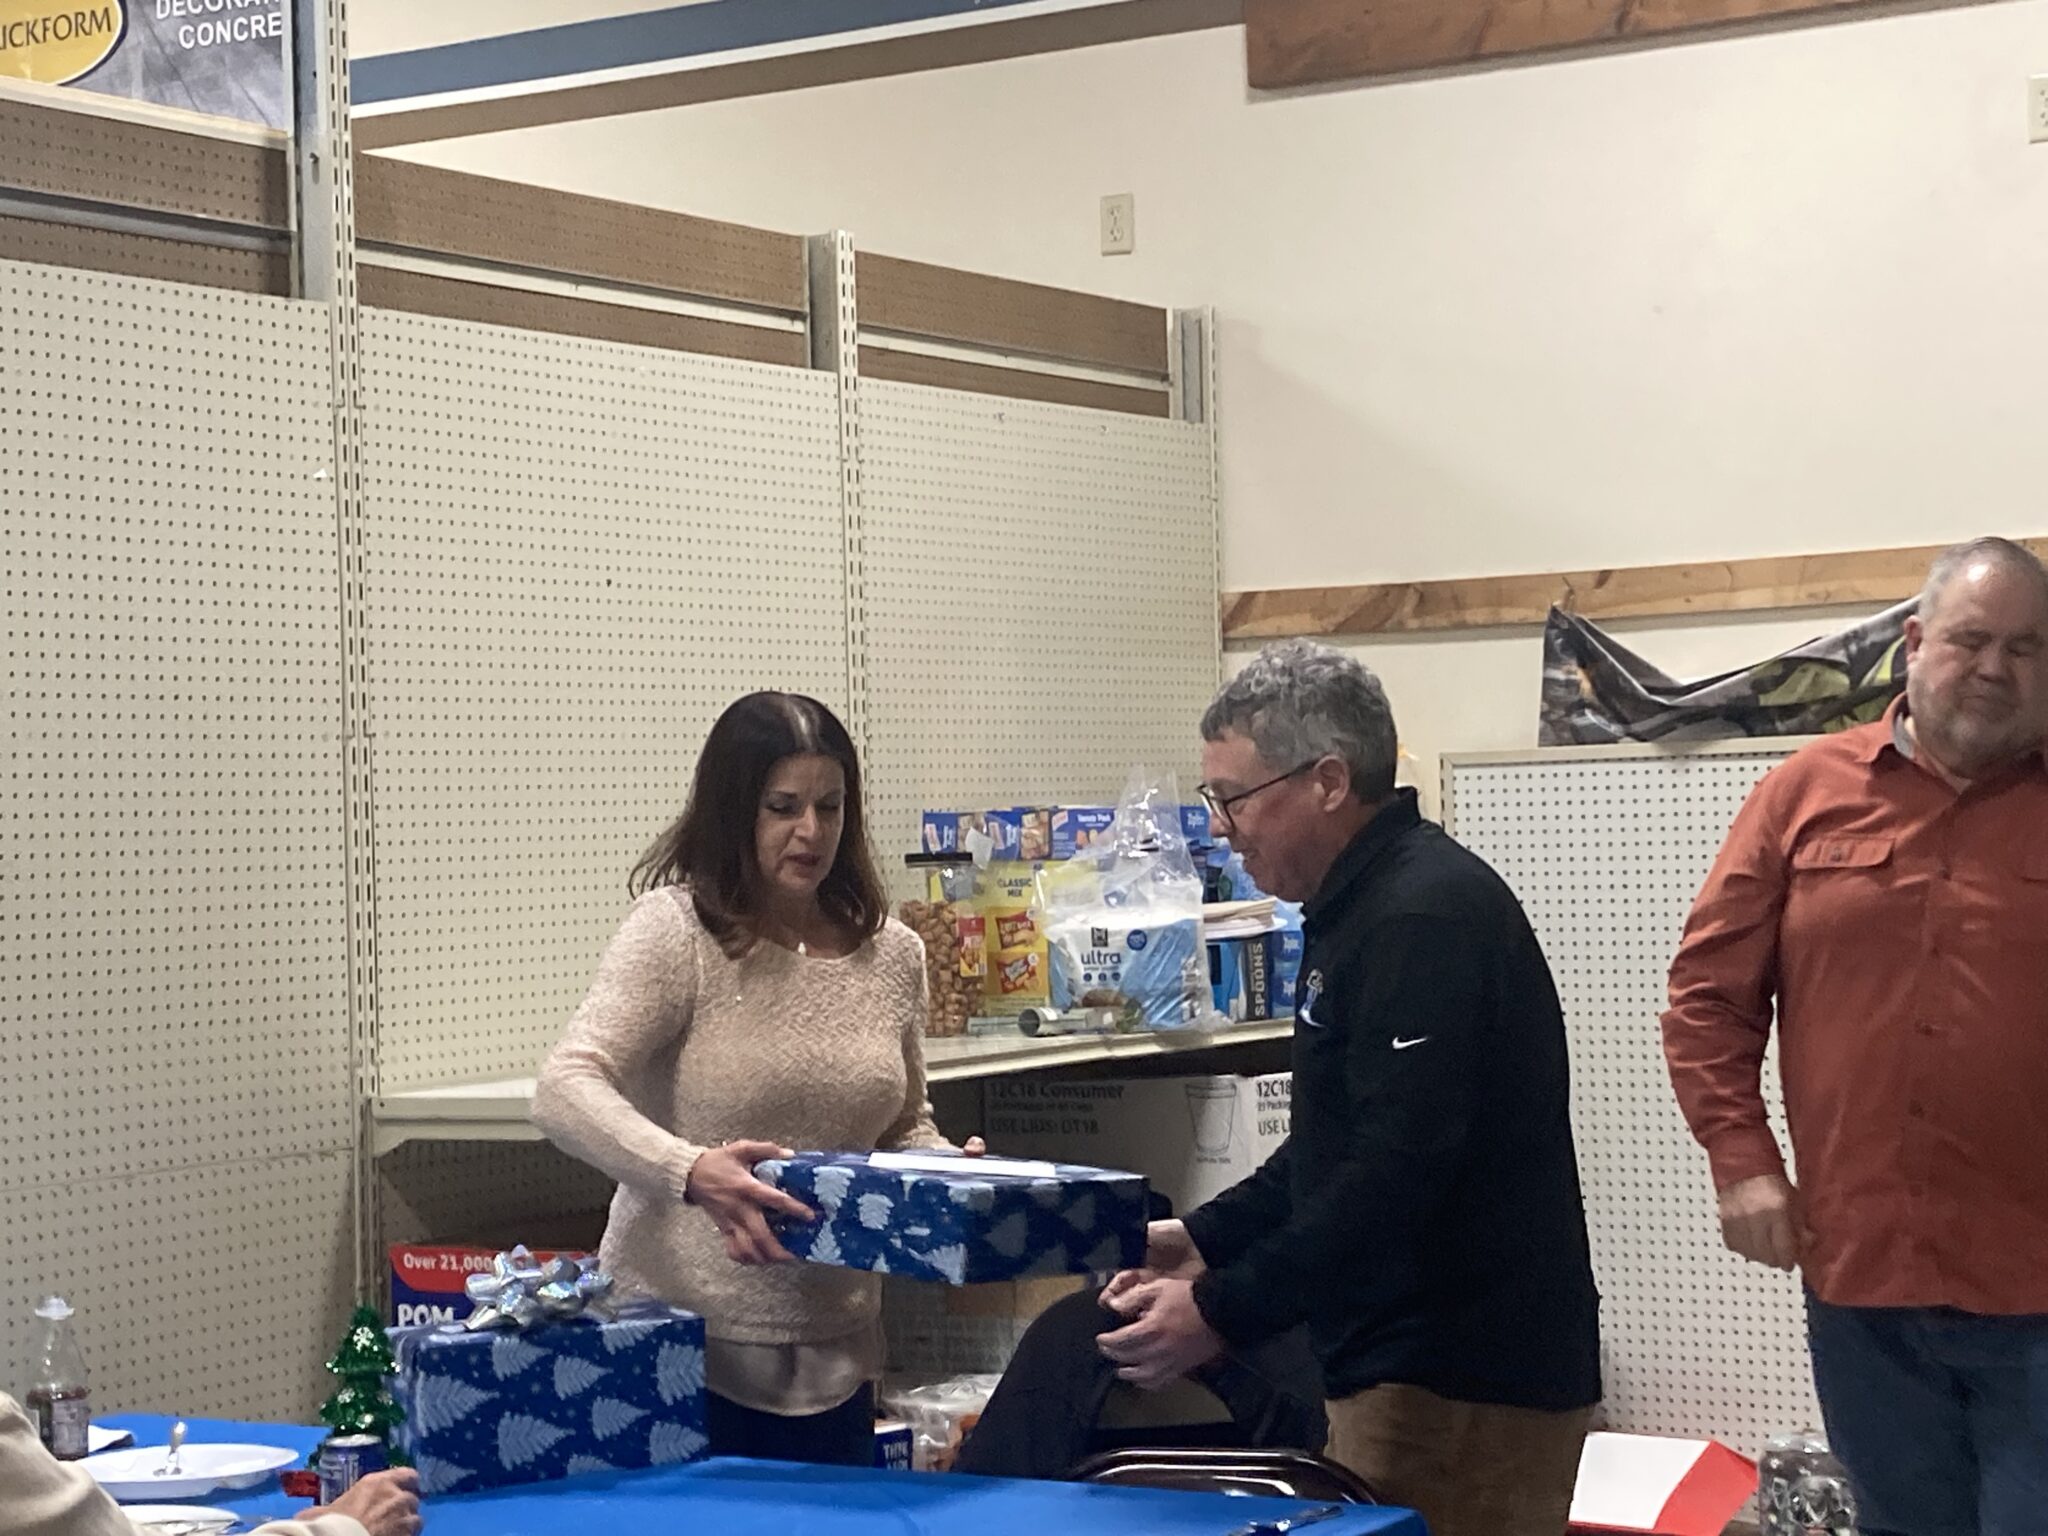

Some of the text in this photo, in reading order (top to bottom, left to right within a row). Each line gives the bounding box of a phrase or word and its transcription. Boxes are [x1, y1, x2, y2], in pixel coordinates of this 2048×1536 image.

[0, 7, 111, 50] ICKFORM
[179, 12, 282, 49] CONCRE
[997, 878, 1032, 888] CLASSIC
[1081, 950, 1121, 965] ultra
[1252, 942, 1265, 1016] SPOONS
[1040, 1084, 1124, 1099] Consumer
[1257, 1079, 1292, 1097] 12C18
[1258, 1120, 1280, 1136] USE
[403, 1253, 493, 1273] Over 21,000
[398, 1303, 454, 1327] POM
